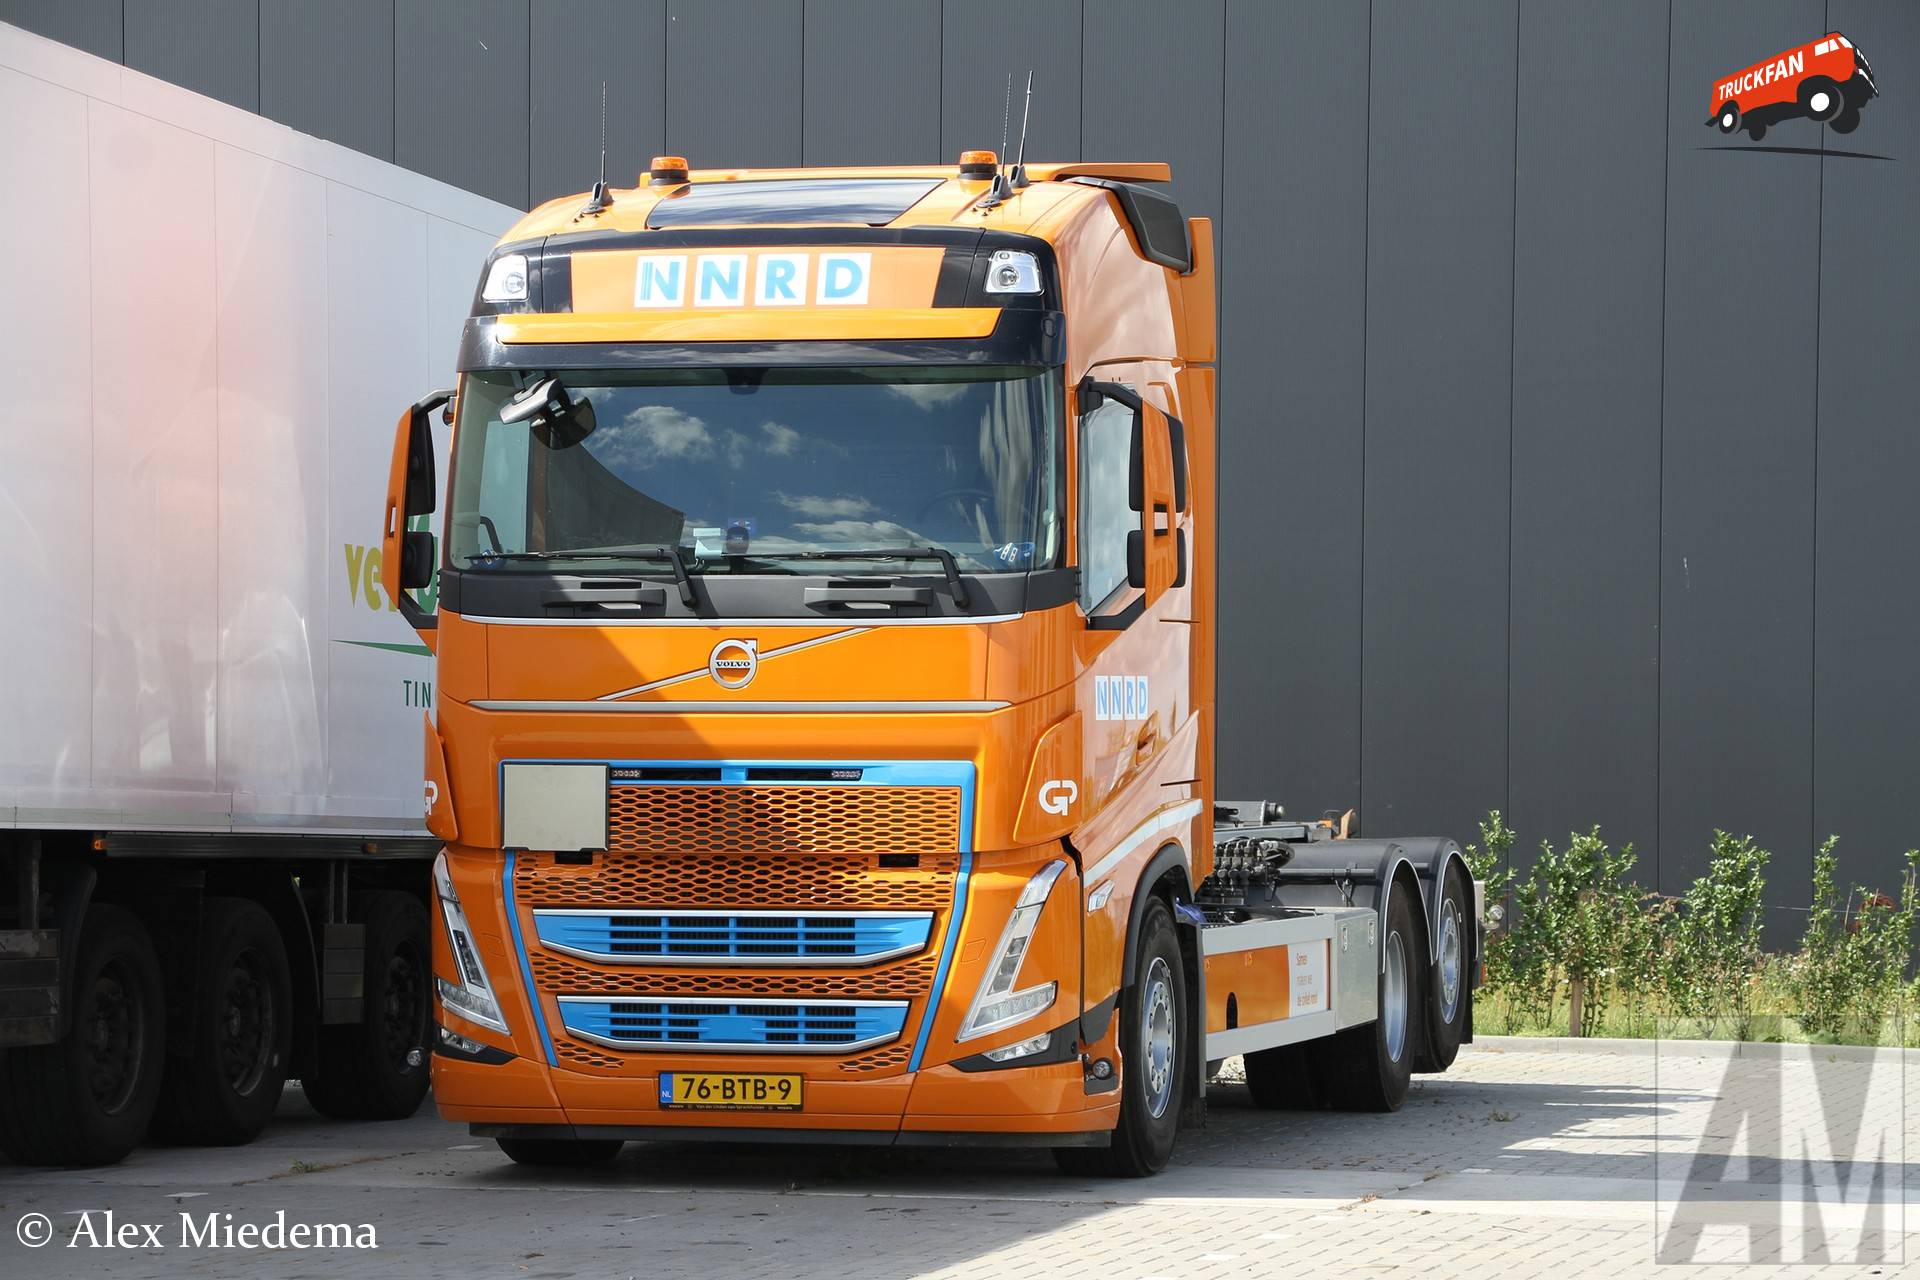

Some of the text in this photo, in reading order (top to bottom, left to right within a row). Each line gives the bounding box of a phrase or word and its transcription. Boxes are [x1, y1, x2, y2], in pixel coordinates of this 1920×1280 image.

[640, 258, 863, 301] NNRD
[403, 679, 437, 709] TIN
[1096, 680, 1147, 715] NNRD
[661, 1077, 792, 1101] NL 76-BTB-9
